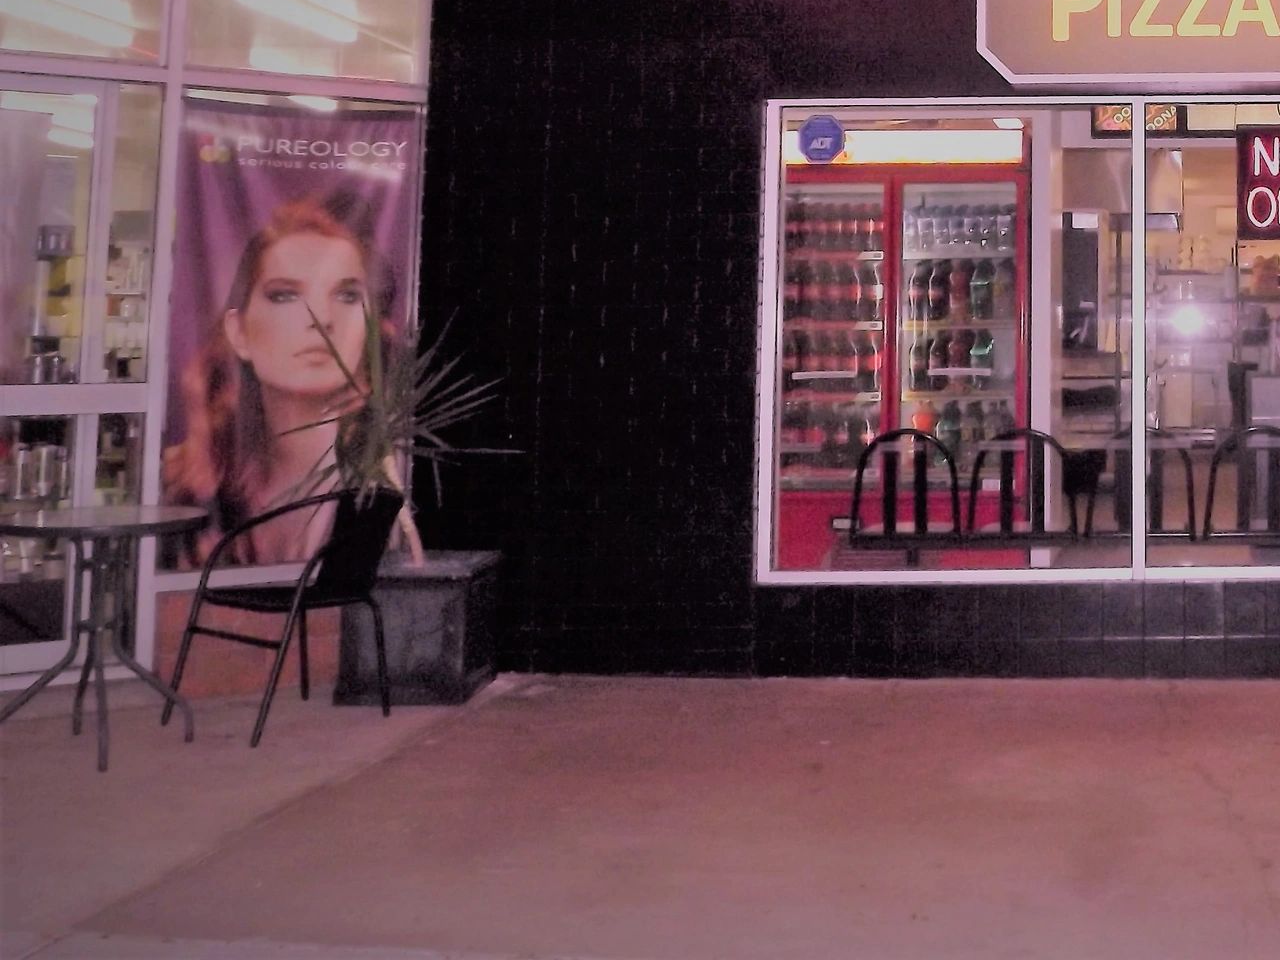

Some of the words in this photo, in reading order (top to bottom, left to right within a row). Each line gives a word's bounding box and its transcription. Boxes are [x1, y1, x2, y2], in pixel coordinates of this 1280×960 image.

[236, 136, 408, 158] PUREOLOGY
[809, 136, 833, 150] ADT
[237, 157, 302, 170] serious
